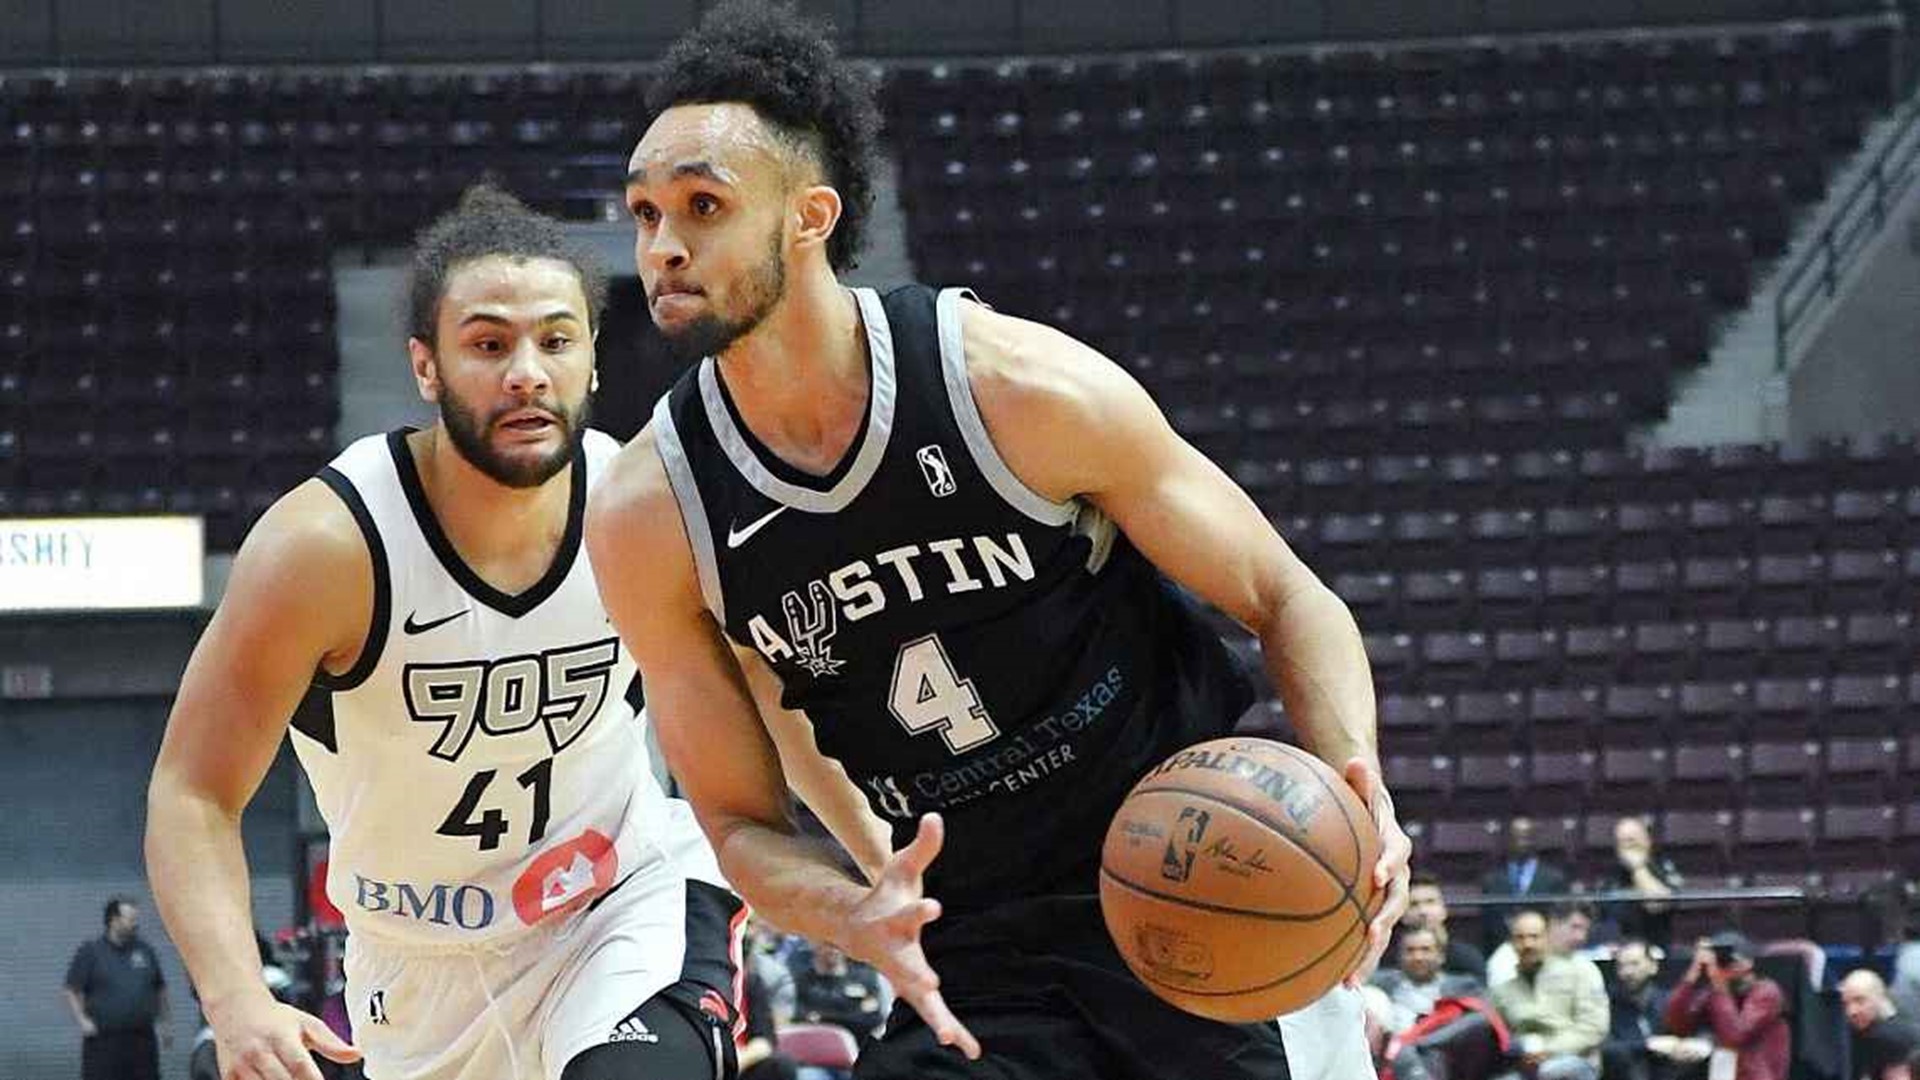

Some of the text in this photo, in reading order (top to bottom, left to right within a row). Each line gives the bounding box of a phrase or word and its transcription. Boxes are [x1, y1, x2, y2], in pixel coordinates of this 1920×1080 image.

[747, 533, 1036, 679] AUSTIN
[402, 636, 620, 762] 905
[887, 632, 1001, 757] 4
[435, 756, 554, 851] 41
[353, 873, 495, 931] BMO
